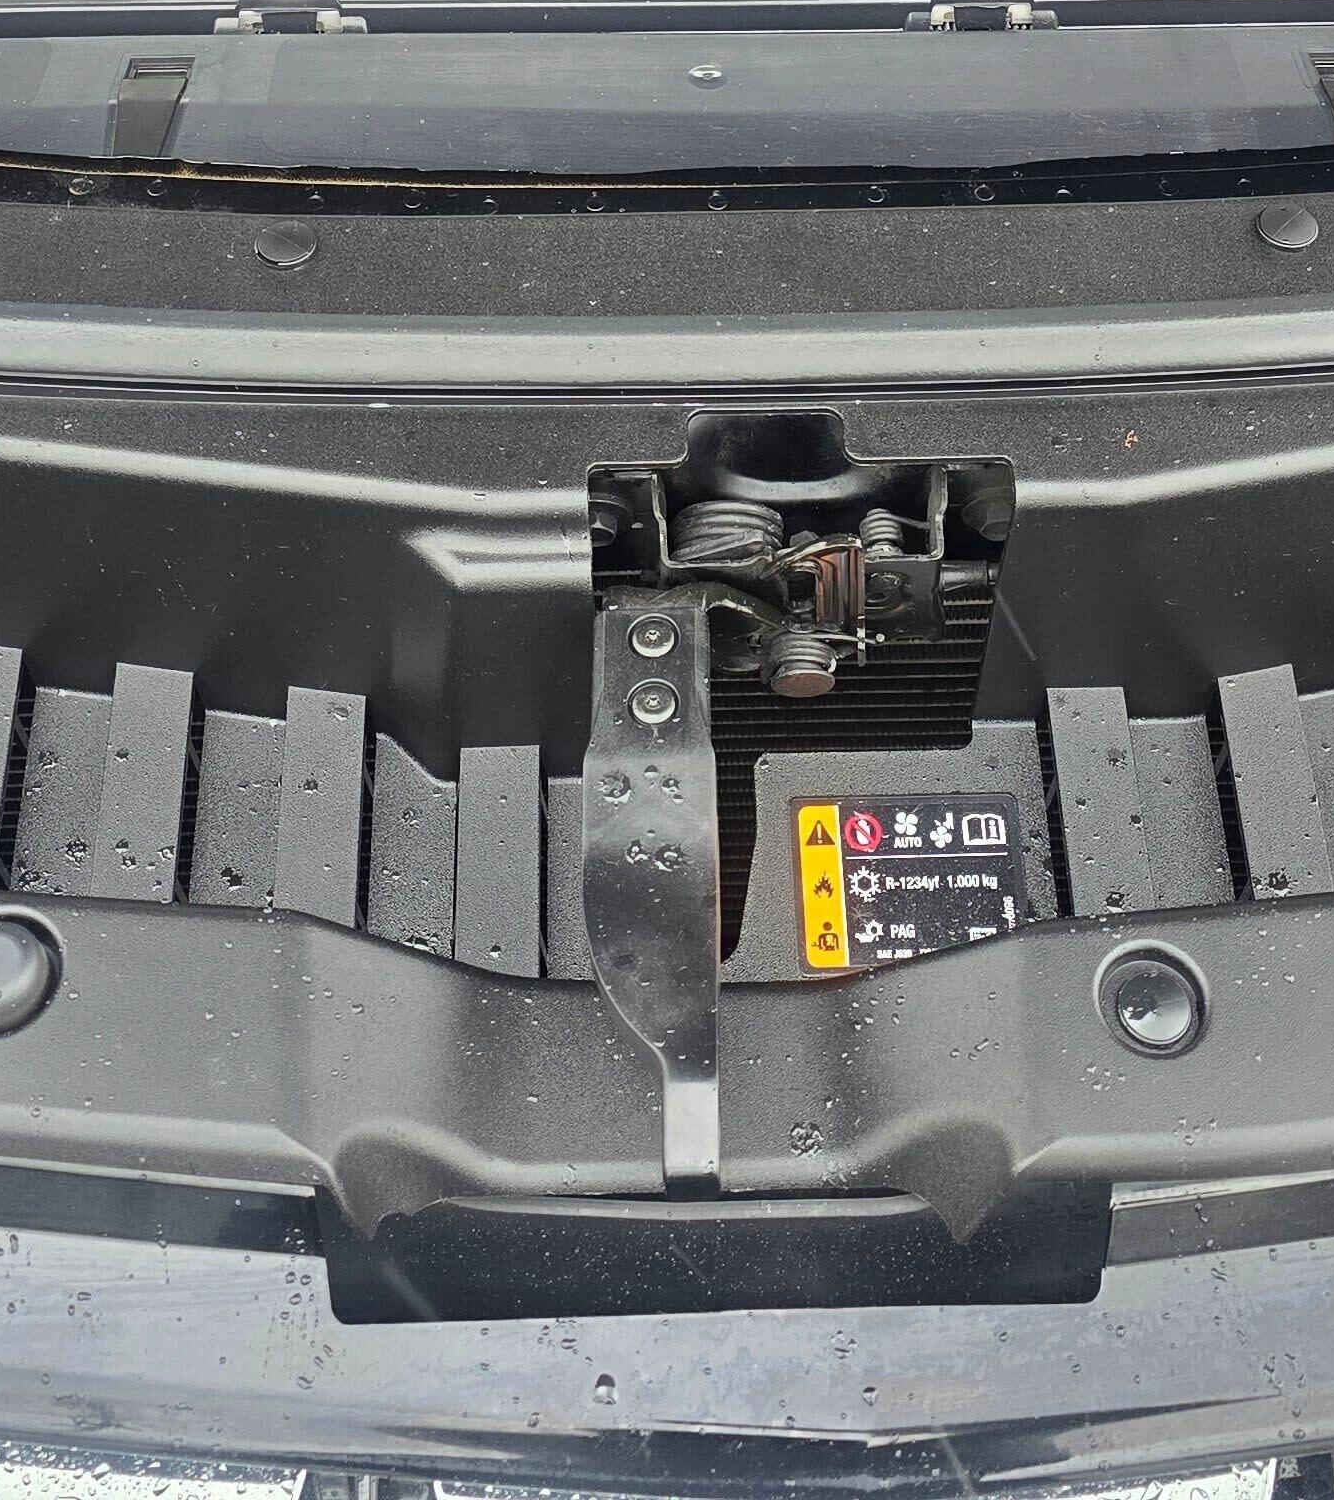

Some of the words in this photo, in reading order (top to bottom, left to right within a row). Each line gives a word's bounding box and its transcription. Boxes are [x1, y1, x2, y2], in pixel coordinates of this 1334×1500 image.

[894, 836, 922, 848] AUTO
[885, 875, 939, 891] R-1234yf
[947, 874, 980, 888] 1.000
[982, 873, 998, 890] kg
[890, 923, 916, 939] PAG
